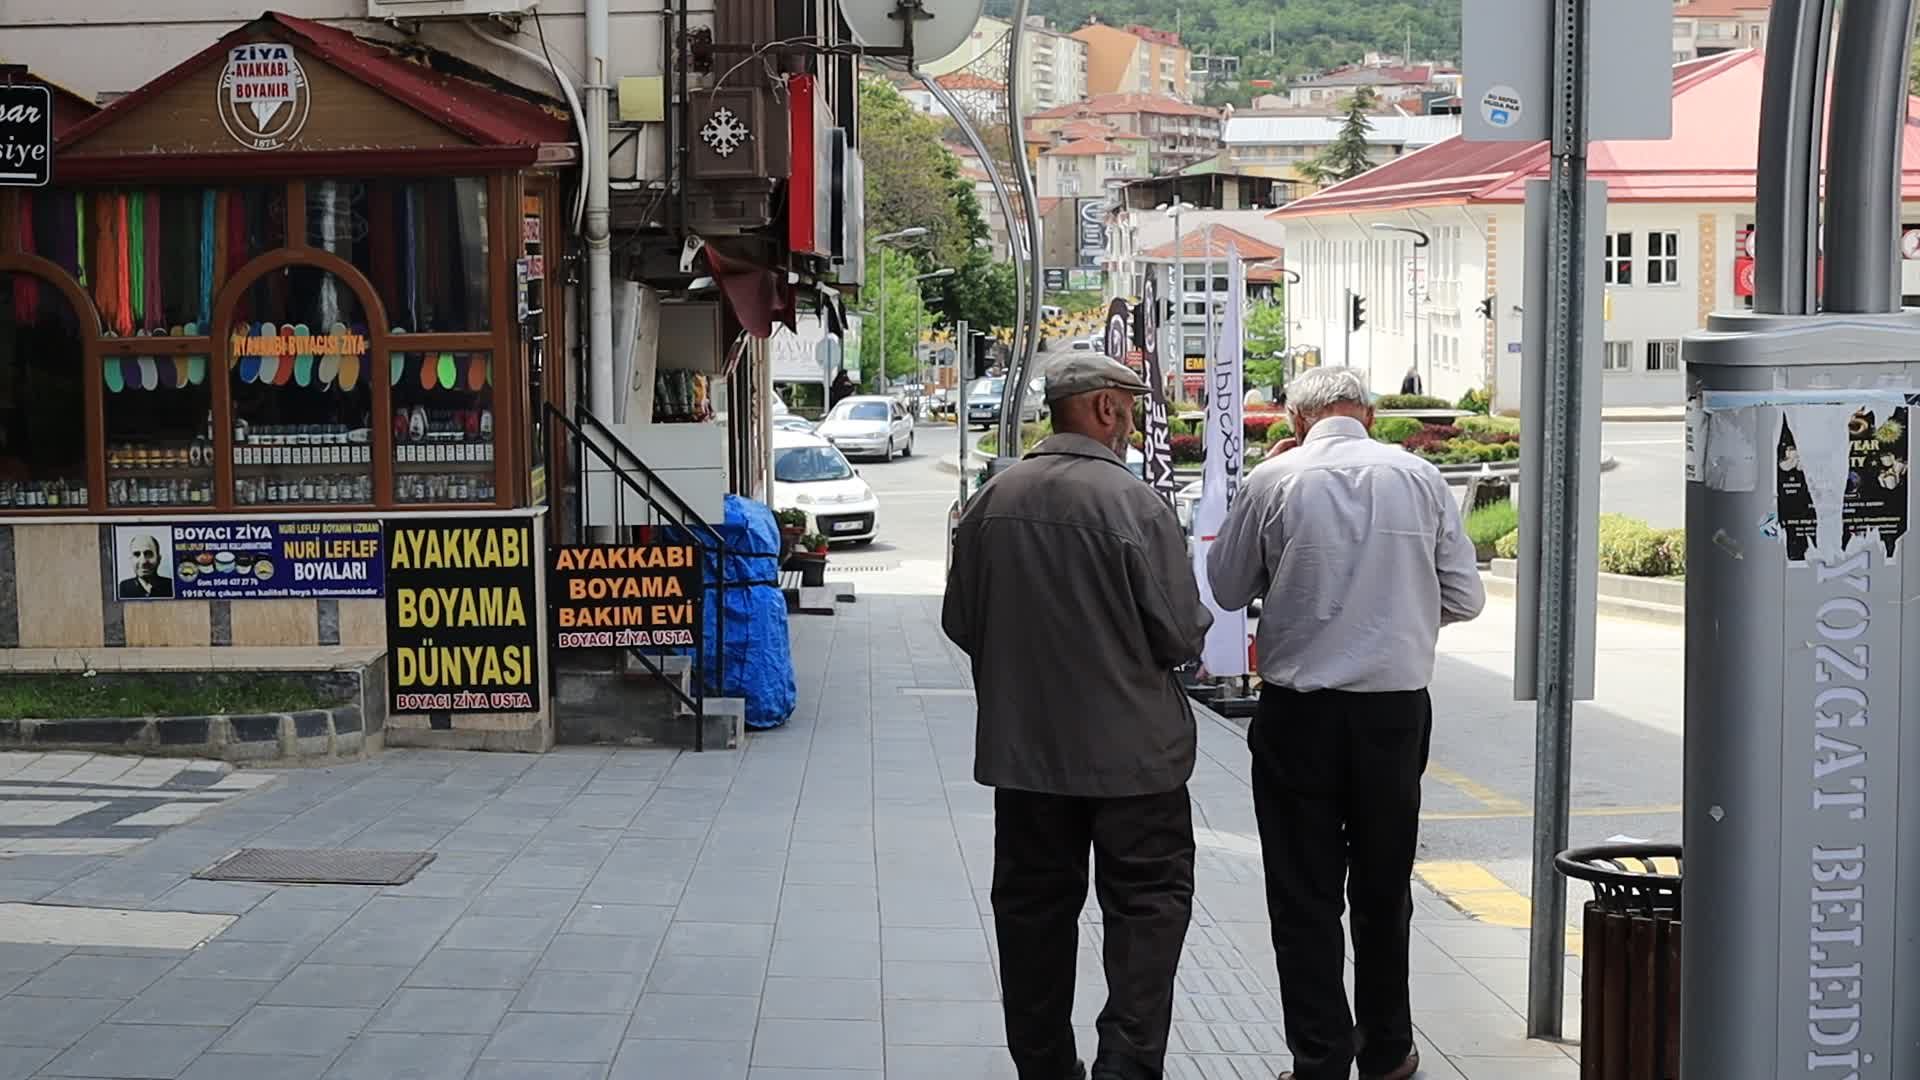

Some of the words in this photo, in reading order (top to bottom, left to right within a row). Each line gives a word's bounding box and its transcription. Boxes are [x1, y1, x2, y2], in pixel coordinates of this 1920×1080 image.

[234, 46, 288, 61] ZİYA
[236, 62, 289, 78] AYAKKABI
[236, 83, 289, 98] BOYANIR
[341, 331, 366, 356] ZİYA
[1850, 456, 1867, 467] TY
[174, 527, 231, 541] BOYACI
[235, 523, 273, 540] ZİYA
[284, 536, 320, 559] NURİ
[325, 540, 378, 558] LEFLEF
[391, 528, 529, 569] AYAKKABI
[556, 546, 693, 570] AYAKKABI
[294, 561, 367, 581] BOYALARI
[569, 576, 683, 600] BOYAMA
[397, 587, 527, 628] BOYAMA
[559, 605, 643, 627] BAKIM
[652, 599, 693, 625] EVİ
[559, 631, 613, 648] BOYACI
[615, 628, 650, 646] ZİYA
[652, 629, 694, 645] USTA
[397, 638, 532, 687] DÜNYASI
[1813, 550, 1870, 820] YOZGAT
[397, 693, 451, 710] BOYACI
[453, 690, 490, 708] ZİYA
[491, 692, 532, 708] USTA
[1807, 843, 1873, 1080] BELEDİ
